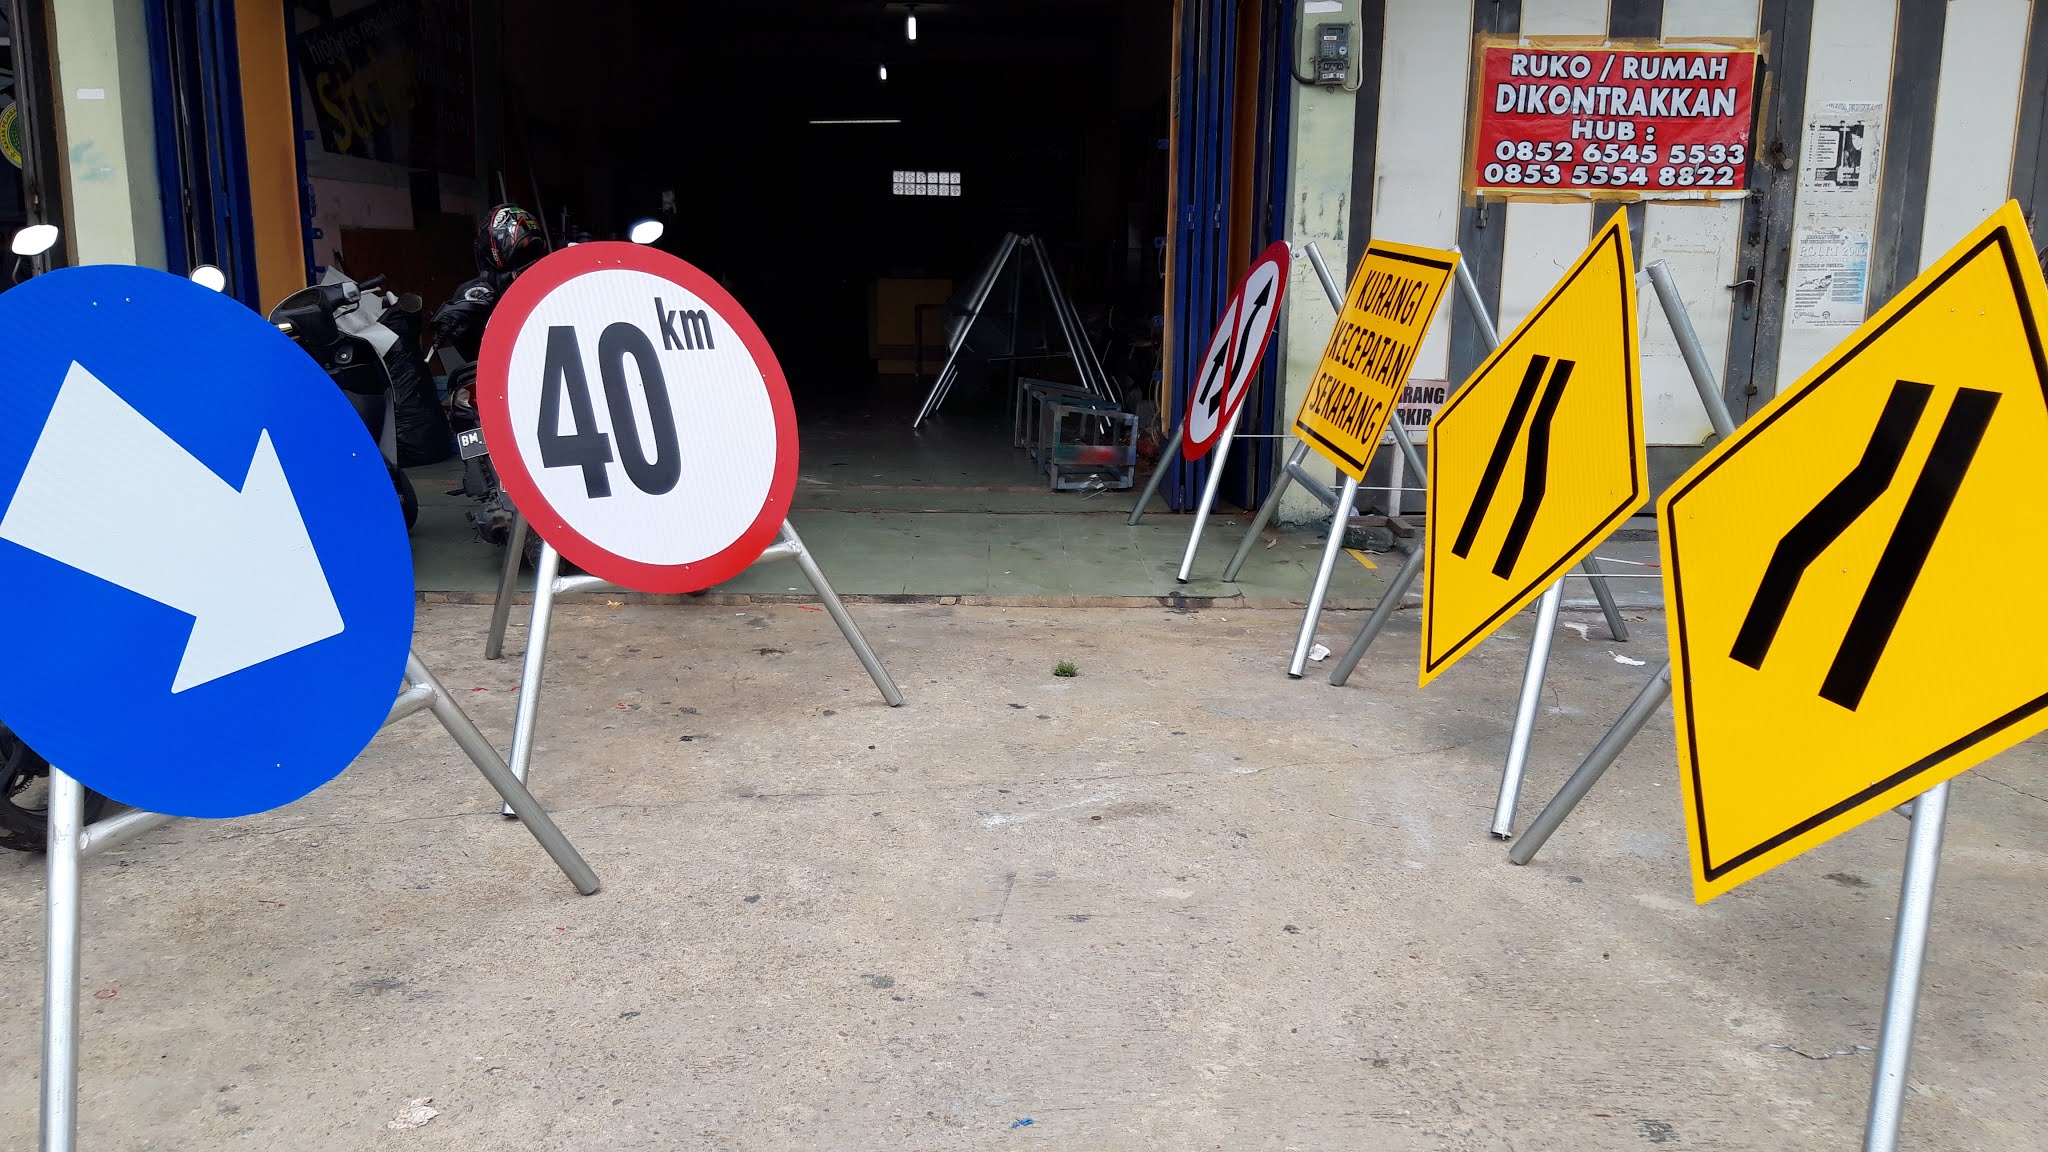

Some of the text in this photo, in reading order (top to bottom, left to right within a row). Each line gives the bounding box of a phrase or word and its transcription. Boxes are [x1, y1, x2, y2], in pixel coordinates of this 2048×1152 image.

[1511, 54, 1728, 82] RUKO / RUMAH
[1495, 83, 1736, 117] DIKONTRAKKAN
[1571, 120, 1656, 142] HUB :
[1495, 141, 1745, 165] 0852 6545 5533
[1483, 163, 1734, 187] 0853 5554 8822
[1354, 269, 1430, 327] KURANGI
[1328, 320, 1411, 389] KECEPATAN
[537, 296, 715, 499] 40 km
[1308, 372, 1383, 445] SEKARANG
